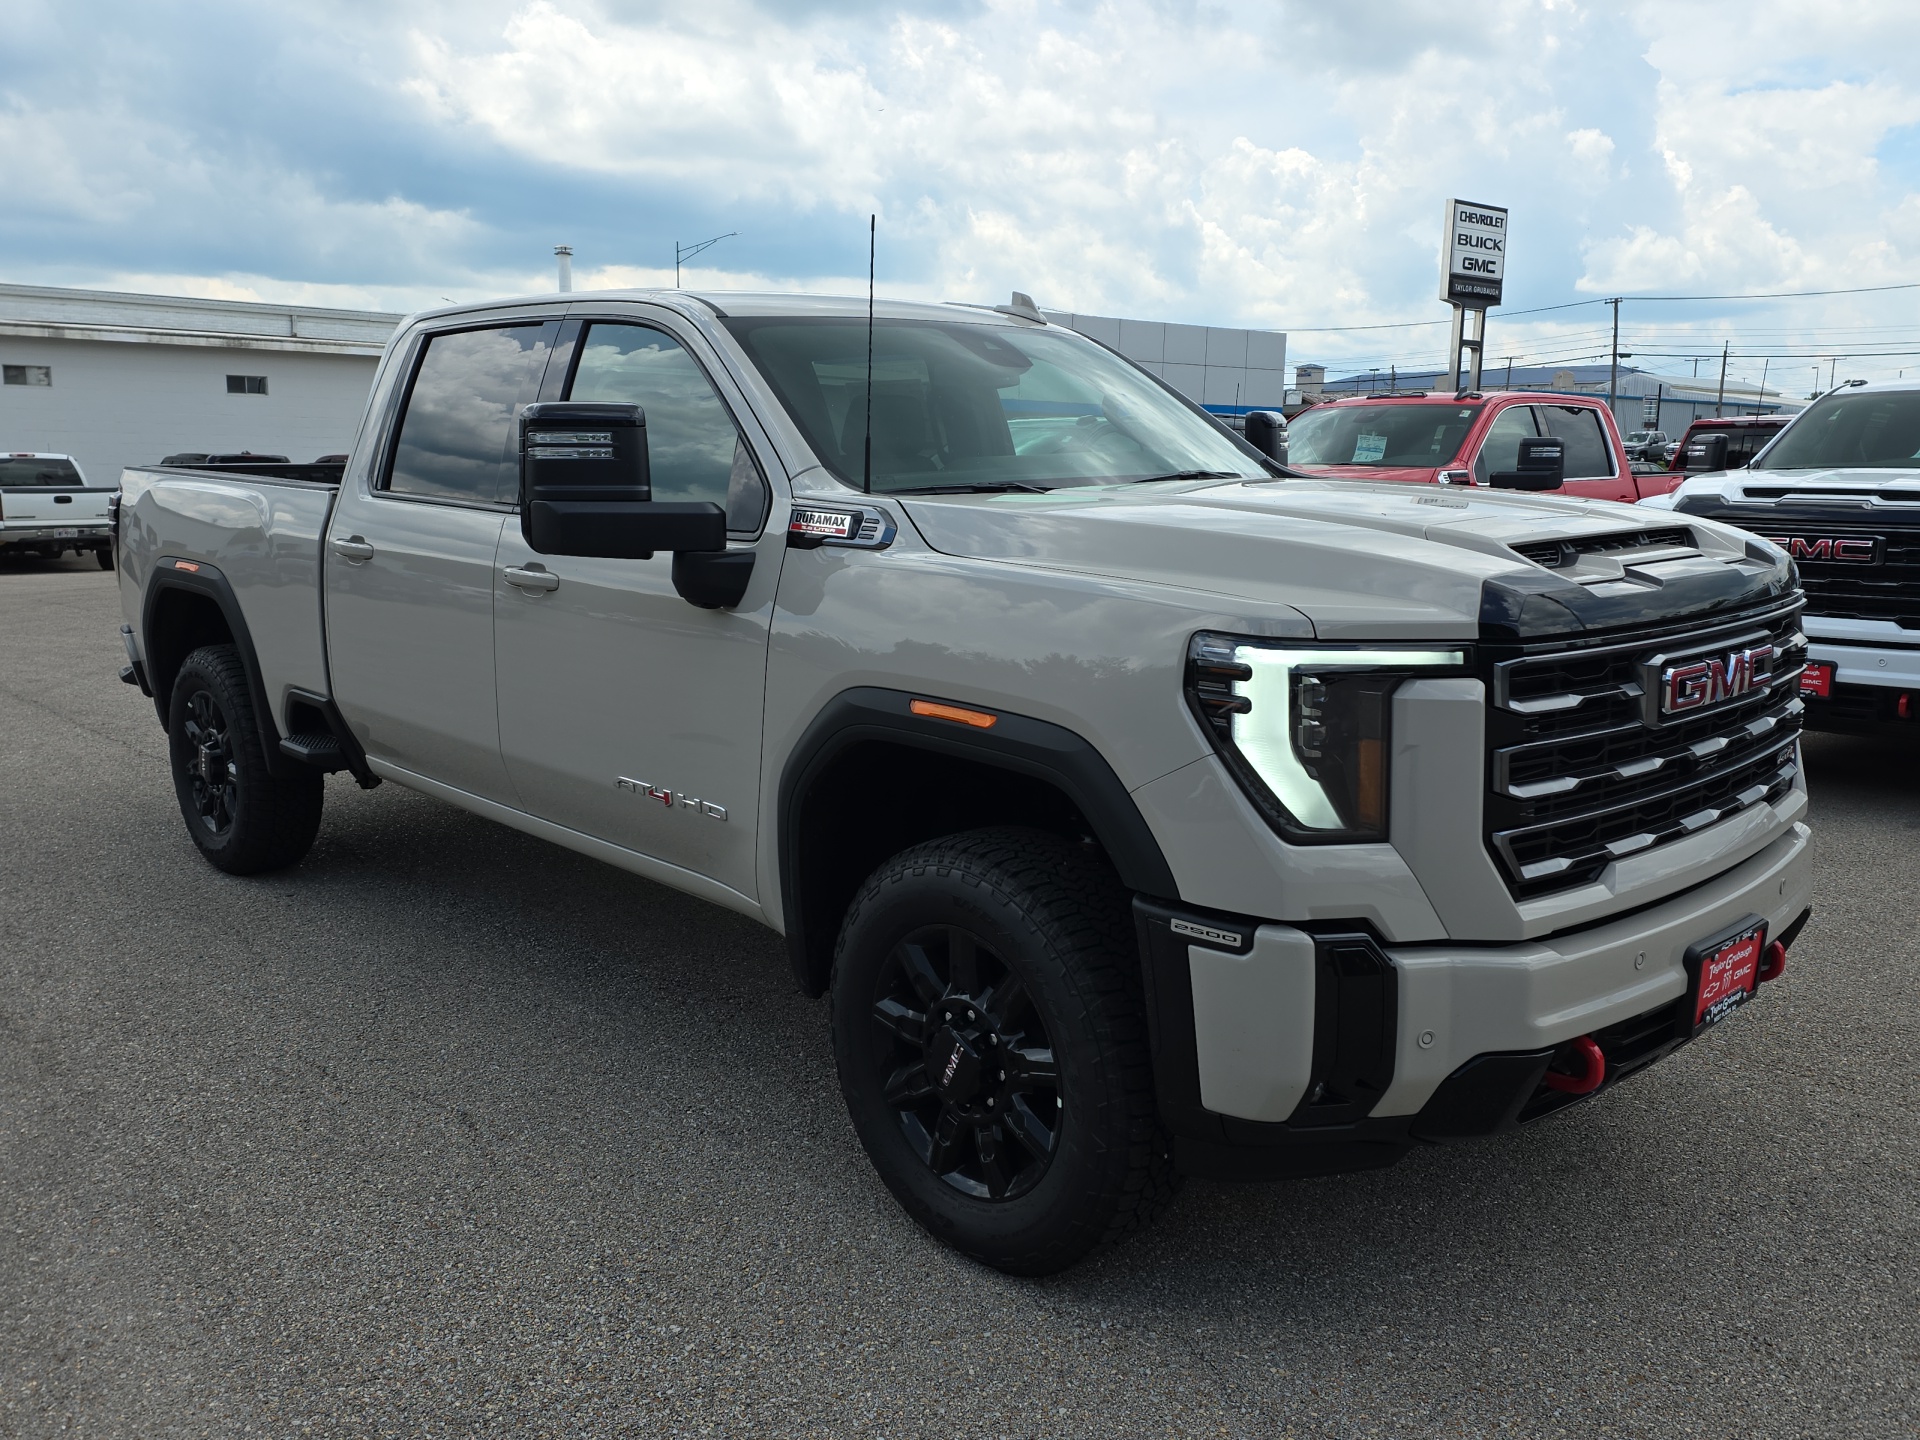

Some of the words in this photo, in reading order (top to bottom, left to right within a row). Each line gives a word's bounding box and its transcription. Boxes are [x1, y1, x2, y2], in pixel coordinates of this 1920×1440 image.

[1460, 211, 1504, 228] CHEVROLET
[1457, 233, 1502, 251] BUICK
[1462, 257, 1496, 273] GMC
[795, 512, 846, 527] DURAMAX
[1662, 644, 1772, 714] GMC
[614, 776, 673, 807] AT4
[678, 793, 728, 821] HD
[1174, 922, 1237, 942] 2500
[1733, 964, 1751, 979] GMC
[942, 1042, 964, 1087] GMC
